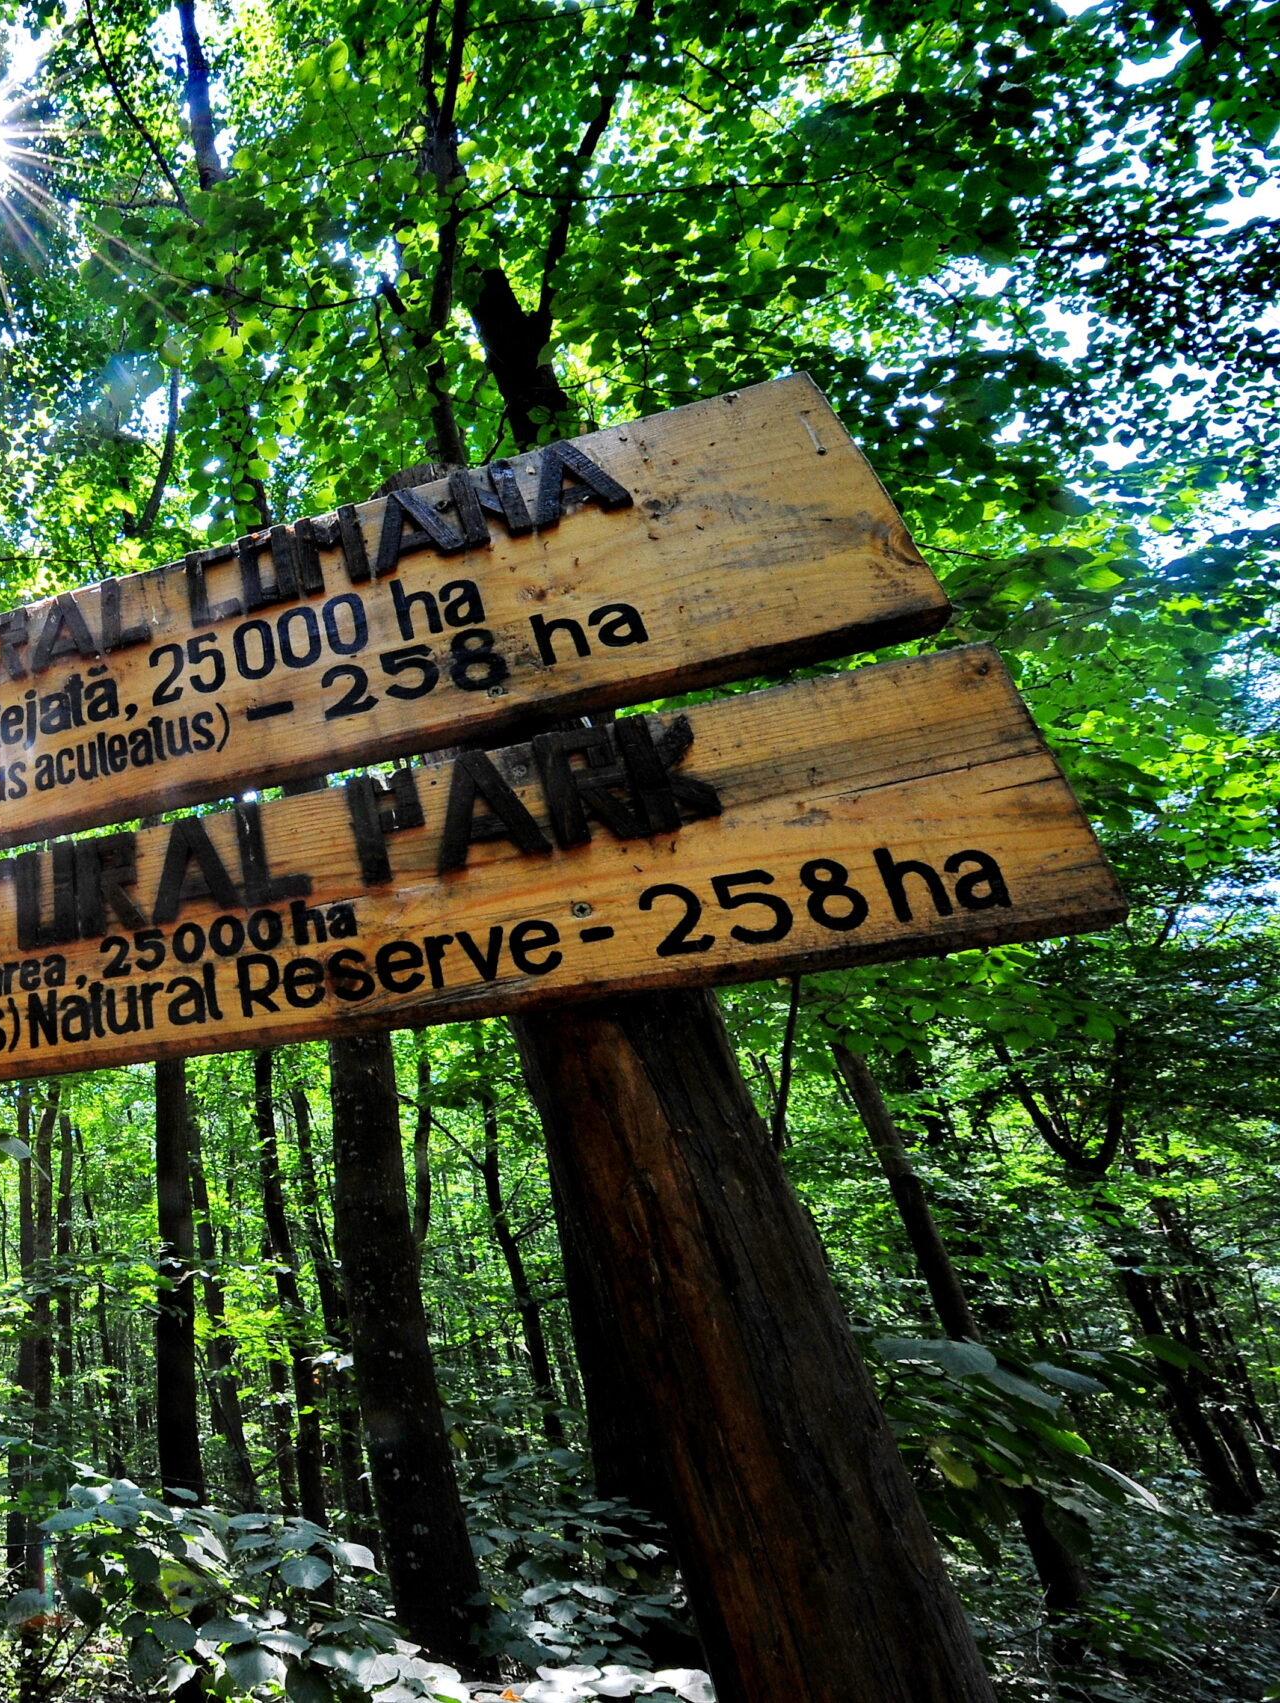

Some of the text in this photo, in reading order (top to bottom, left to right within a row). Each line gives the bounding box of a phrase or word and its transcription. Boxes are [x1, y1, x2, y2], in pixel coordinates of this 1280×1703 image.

[34, 703, 230, 792] aculeatus)
[321, 629, 510, 721] 258
[148, 592, 369, 706] 25000
[389, 579, 486, 641] ha
[347, 714, 722, 887] PARK
[27, 962, 224, 1049] Natural
[236, 919, 563, 1019] Reserve
[638, 858, 870, 957] 258
[873, 847, 1012, 922] ha
[99, 907, 284, 978] 25000
[289, 900, 359, 946] ha
